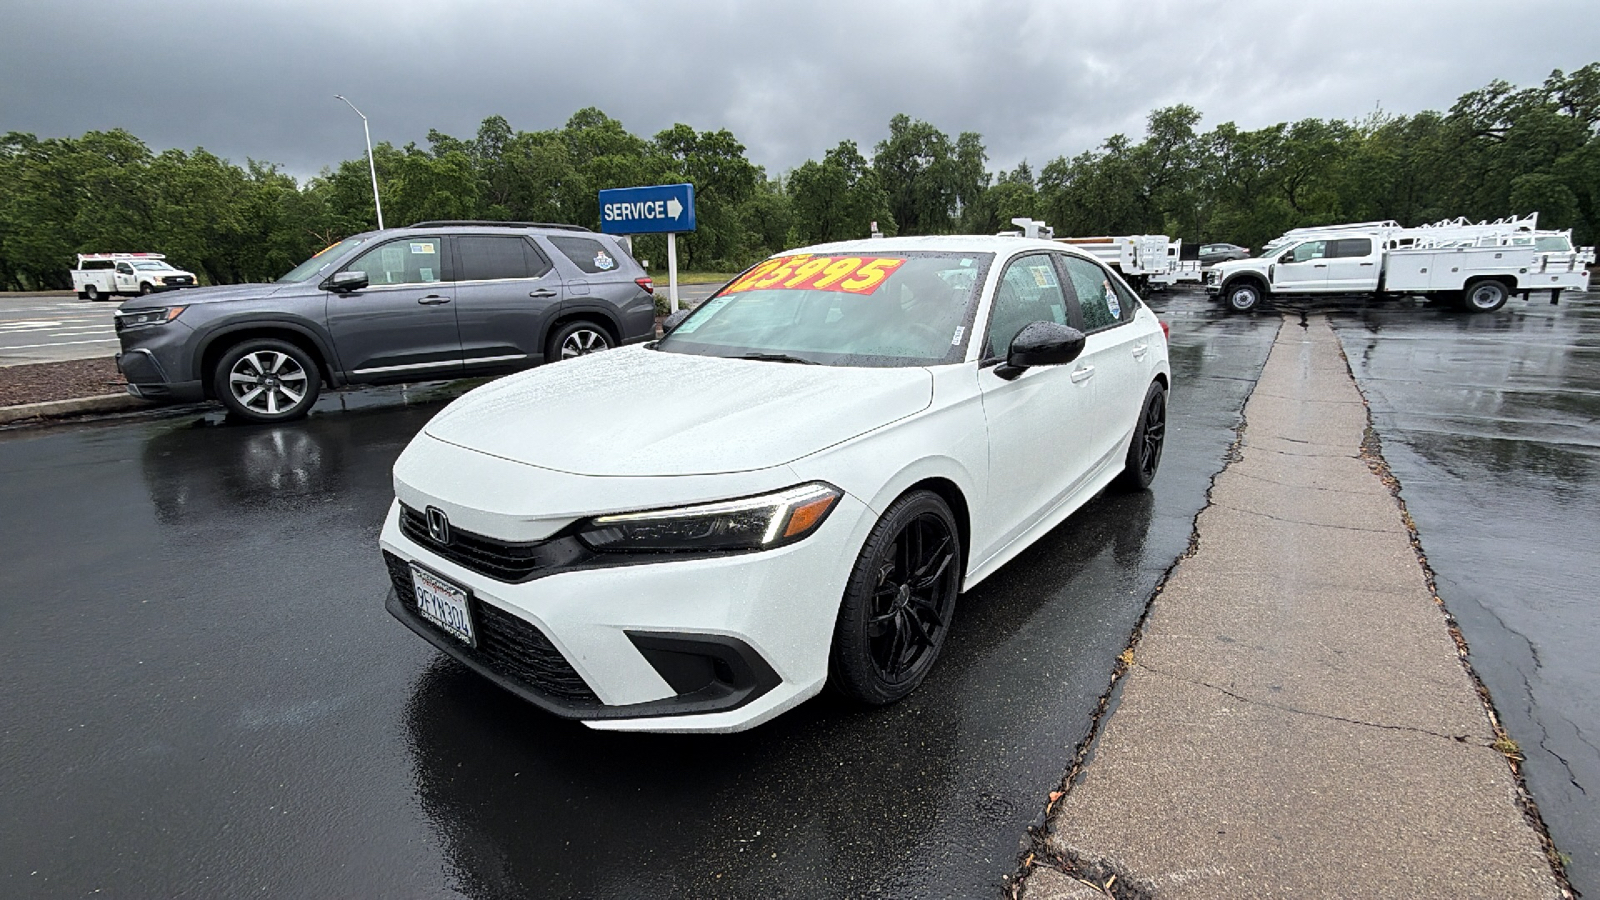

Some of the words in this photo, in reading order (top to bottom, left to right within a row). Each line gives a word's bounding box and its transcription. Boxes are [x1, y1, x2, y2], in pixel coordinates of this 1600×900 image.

[604, 201, 666, 221] SERVICE
[727, 256, 902, 292] 25995
[416, 586, 469, 634] 9FYN304
